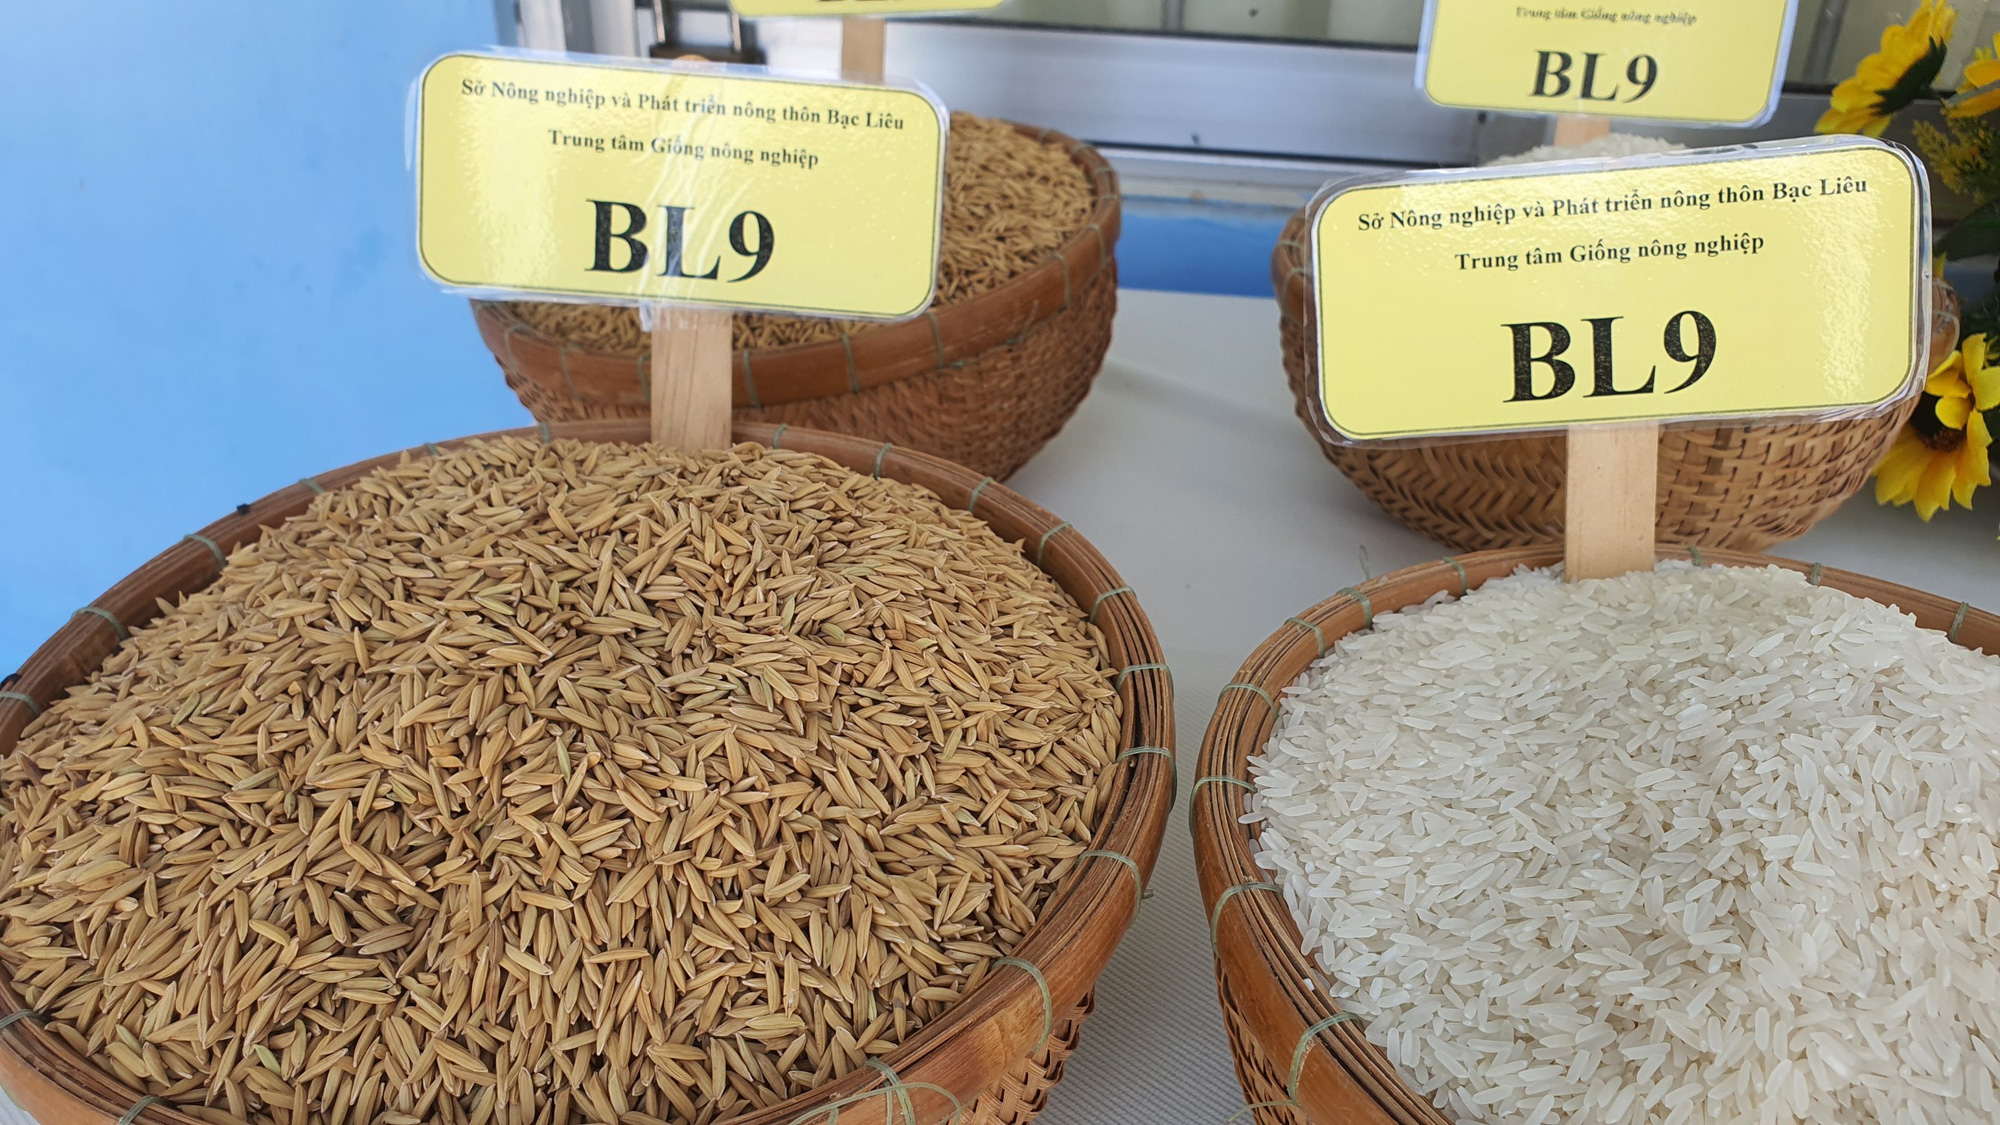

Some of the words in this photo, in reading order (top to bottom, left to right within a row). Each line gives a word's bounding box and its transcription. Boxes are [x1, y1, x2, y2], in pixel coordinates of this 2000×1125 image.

[1527, 50, 1659, 103] BL9
[461, 78, 485, 96] Sở
[491, 79, 539, 103] Nông
[545, 86, 605, 109] nghiệp
[611, 93, 632, 108] và
[638, 94, 679, 112] Phát
[685, 94, 727, 116] triển
[733, 102, 776, 124] nông
[782, 105, 821, 123] thôn
[827, 109, 859, 130] Bạc
[865, 112, 905, 130] Liêu
[548, 129, 605, 152] Trung
[611, 135, 645, 153] tâm
[651, 134, 704, 160] Giống
[710, 143, 754, 164] nông
[760, 150, 819, 169] nghiệp
[1358, 212, 1384, 231] Sở
[1390, 208, 1443, 231] Nông
[1449, 203, 1516, 226] nghiệp
[1522, 202, 1546, 218] và
[1552, 197, 1600, 216] Phát
[1605, 188, 1654, 212] triển
[1660, 191, 1711, 212] nông
[1717, 184, 1765, 203] thôn
[1772, 180, 1813, 204] Bạc
[1819, 176, 1868, 196] Liêu
[585, 199, 775, 283] BL9
[1455, 252, 1519, 271] Trung
[1525, 247, 1563, 265] tâm
[1569, 238, 1632, 263] Giống
[1637, 239, 1688, 258] nông
[1694, 232, 1766, 254] nghiệp
[1501, 310, 1717, 403] BL9
